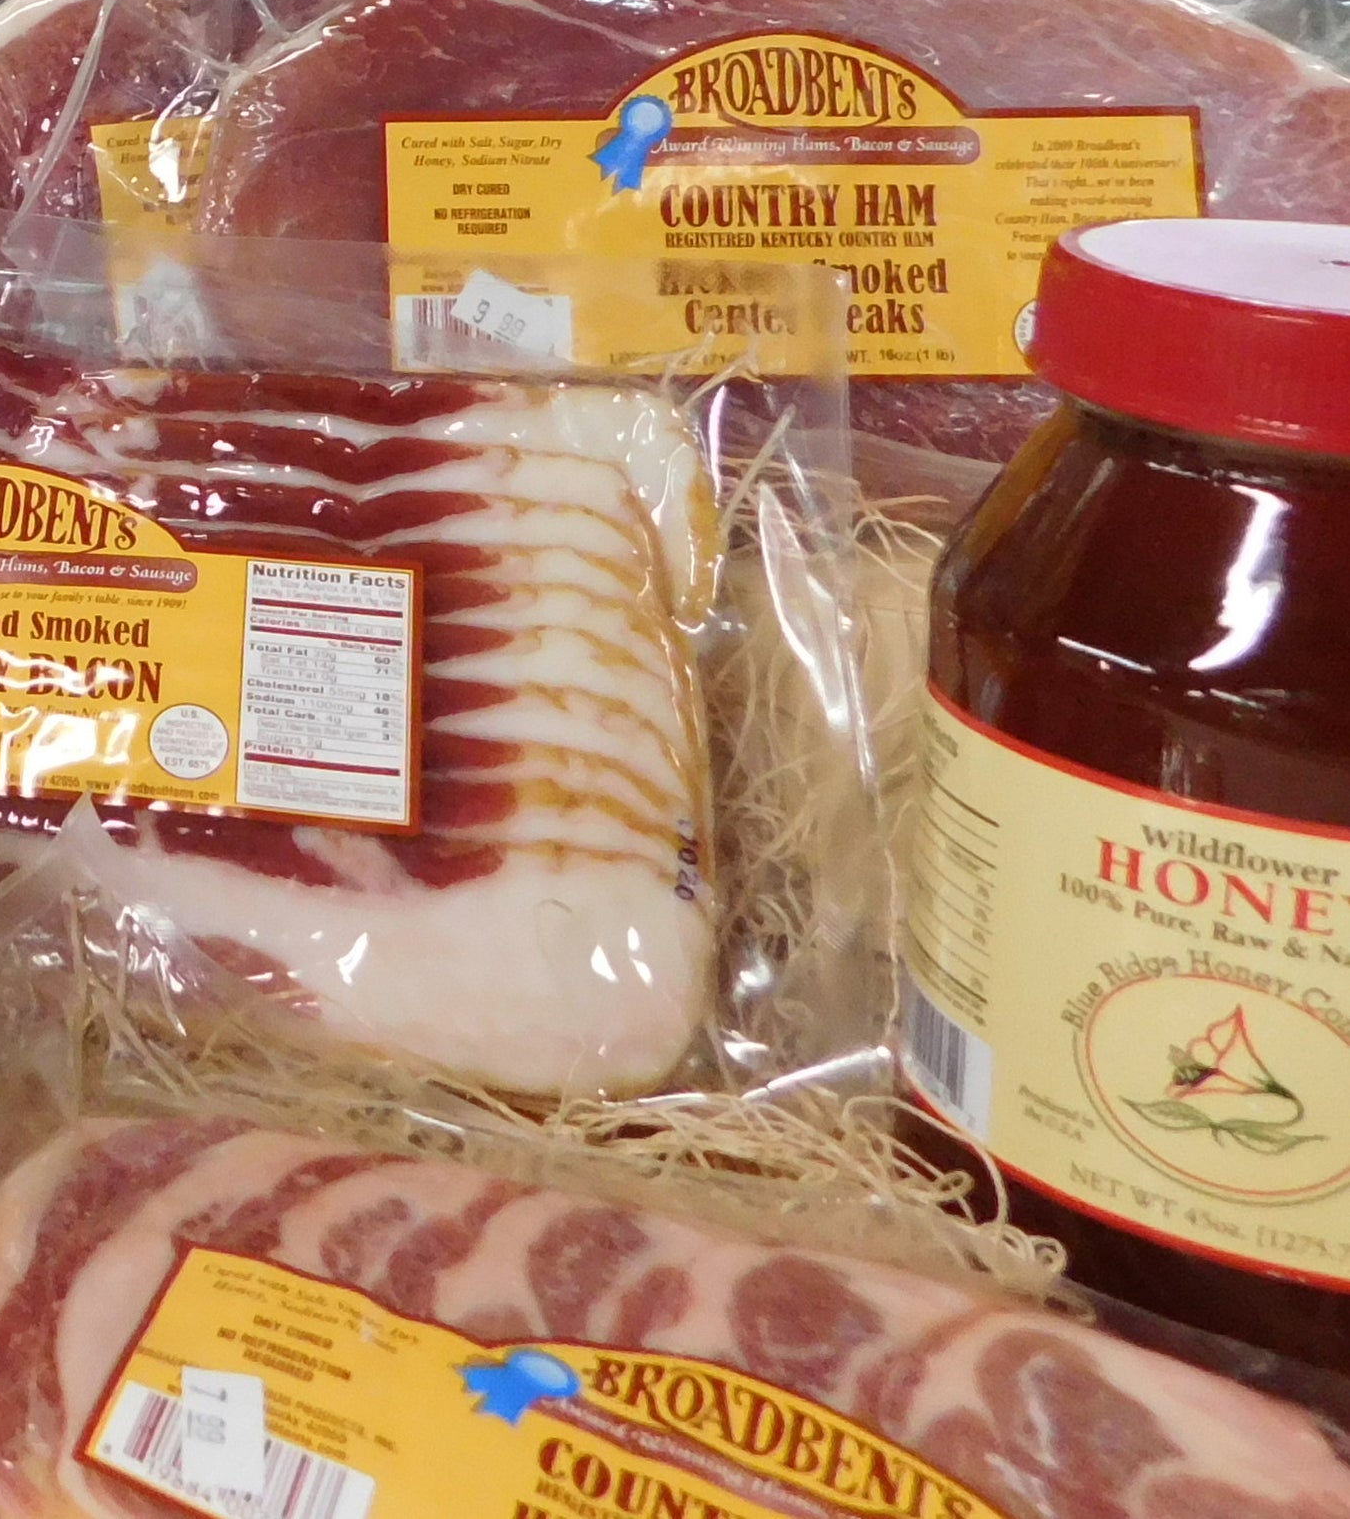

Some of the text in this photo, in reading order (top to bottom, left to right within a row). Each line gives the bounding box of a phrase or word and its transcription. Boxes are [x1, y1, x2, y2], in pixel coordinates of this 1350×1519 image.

[668, 45, 918, 133] BROADBENT'S
[659, 183, 938, 229] COUNTRY HAM
[472, 299, 488, 325] 9
[0, 555, 48, 574] Hams,
[53, 560, 105, 576] Bacon
[110, 563, 126, 576] &
[129, 564, 192, 582] Sausage
[253, 563, 406, 589] Nutrition Facts
[30, 610, 150, 648] Smoked
[1140, 824, 1340, 888] Wildflower
[1097, 835, 1350, 937] HONE
[580, 1354, 973, 1519] BROADBENT'S
